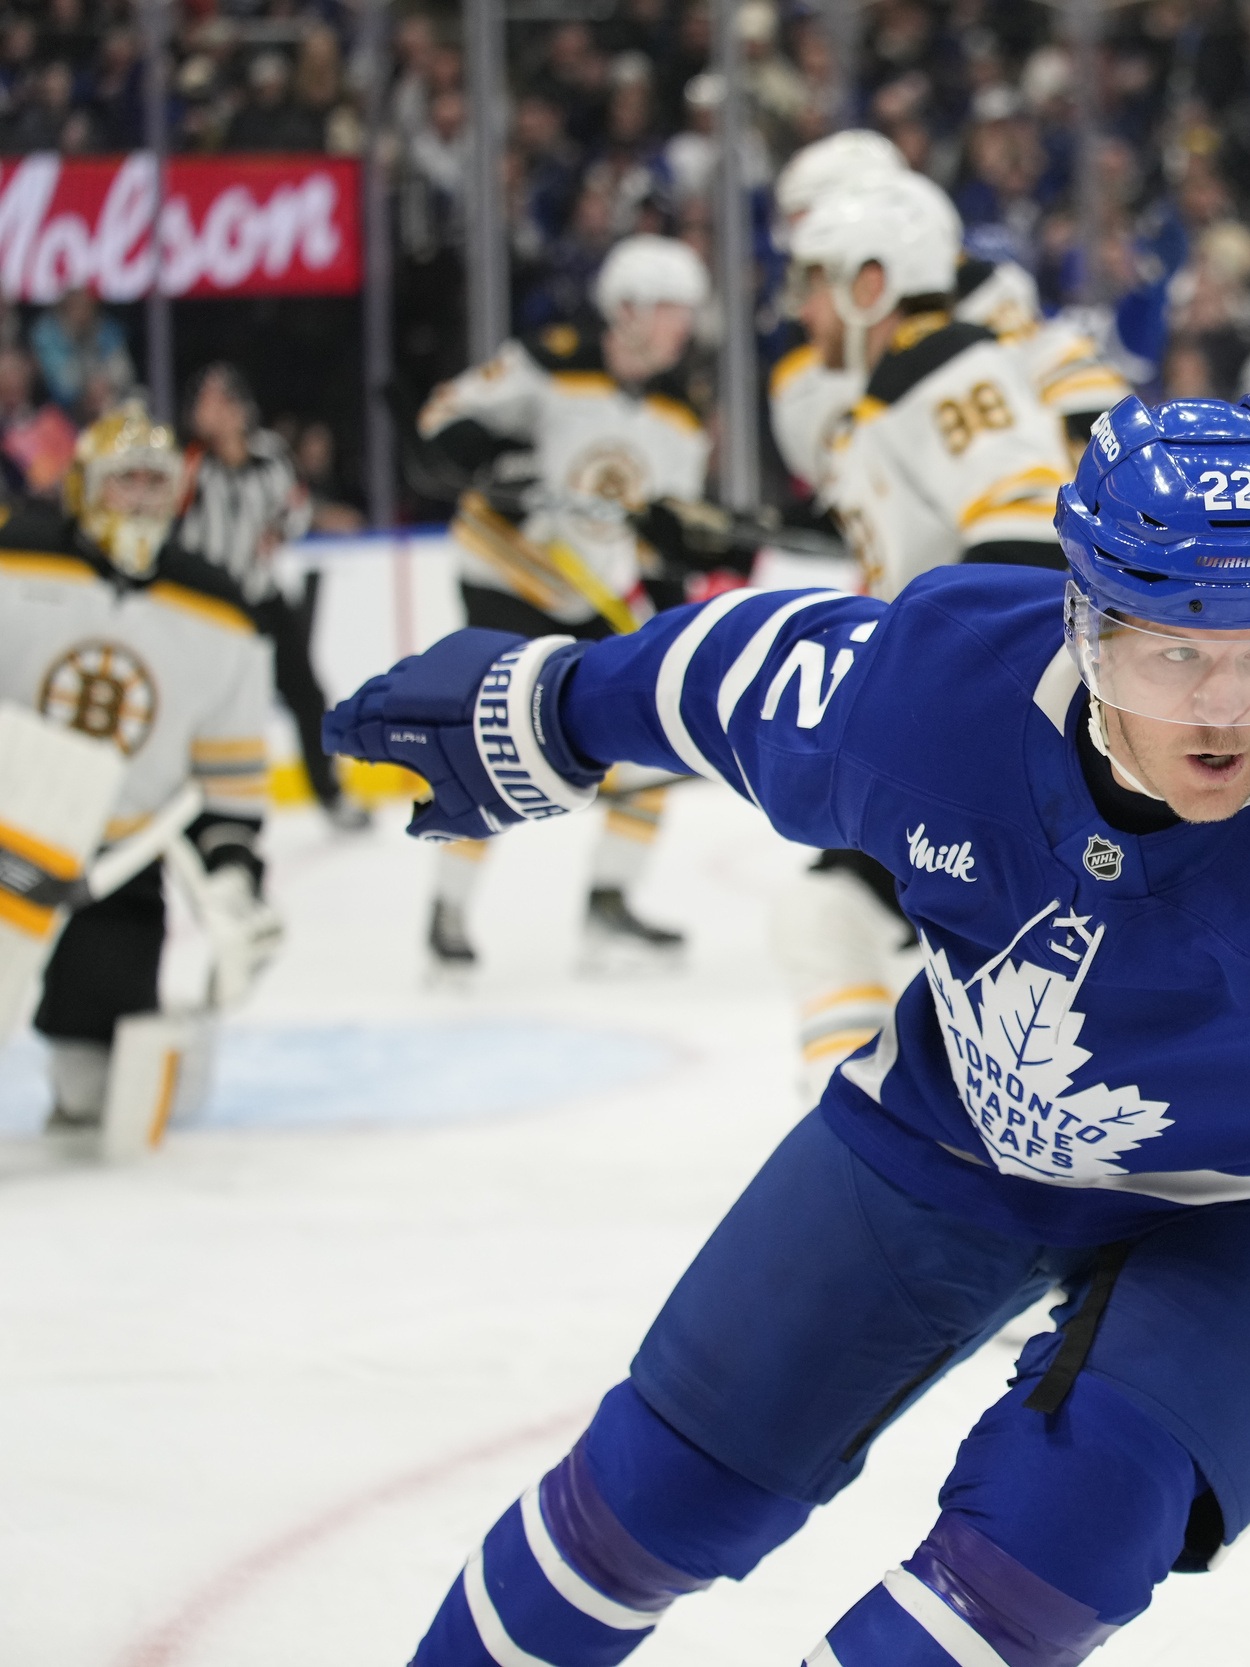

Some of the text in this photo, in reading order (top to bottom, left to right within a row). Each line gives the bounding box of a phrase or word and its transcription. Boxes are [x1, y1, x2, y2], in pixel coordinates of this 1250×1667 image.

[1090, 411, 1120, 462] OREO
[760, 619, 879, 730] 2
[390, 731, 427, 745] ALPHA
[906, 823, 978, 883] Milk
[1090, 852, 1116, 867] NHL
[947, 1025, 1107, 1146] TORONTO
[966, 1065, 1075, 1150] MAPLE
[965, 1088, 1074, 1170] LEAFS
